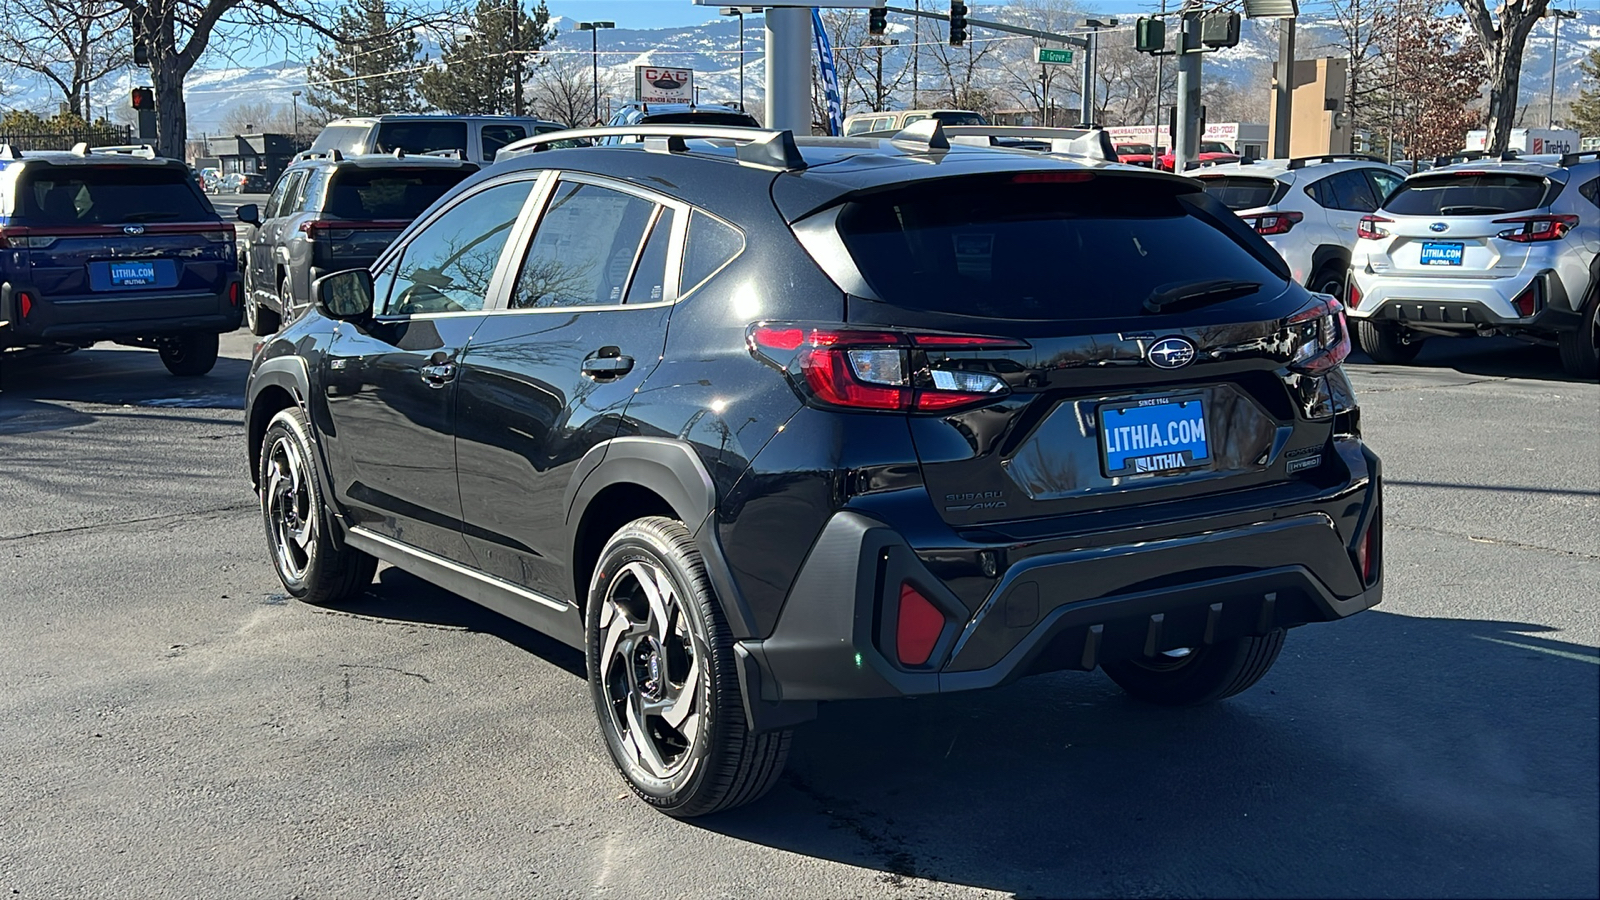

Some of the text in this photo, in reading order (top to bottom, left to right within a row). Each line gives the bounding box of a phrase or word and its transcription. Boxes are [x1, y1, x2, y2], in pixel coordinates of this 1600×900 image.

[1544, 140, 1571, 154] TireHub
[1422, 249, 1462, 259] LITHIA.COM
[112, 268, 155, 278] LITHIA.COM
[1138, 399, 1155, 407] SINCE
[1105, 418, 1206, 453] LITHIA.COM
[1146, 453, 1186, 471] LITHIA
[1293, 459, 1317, 469] HYBRID
[946, 491, 1003, 501] SUBARU
